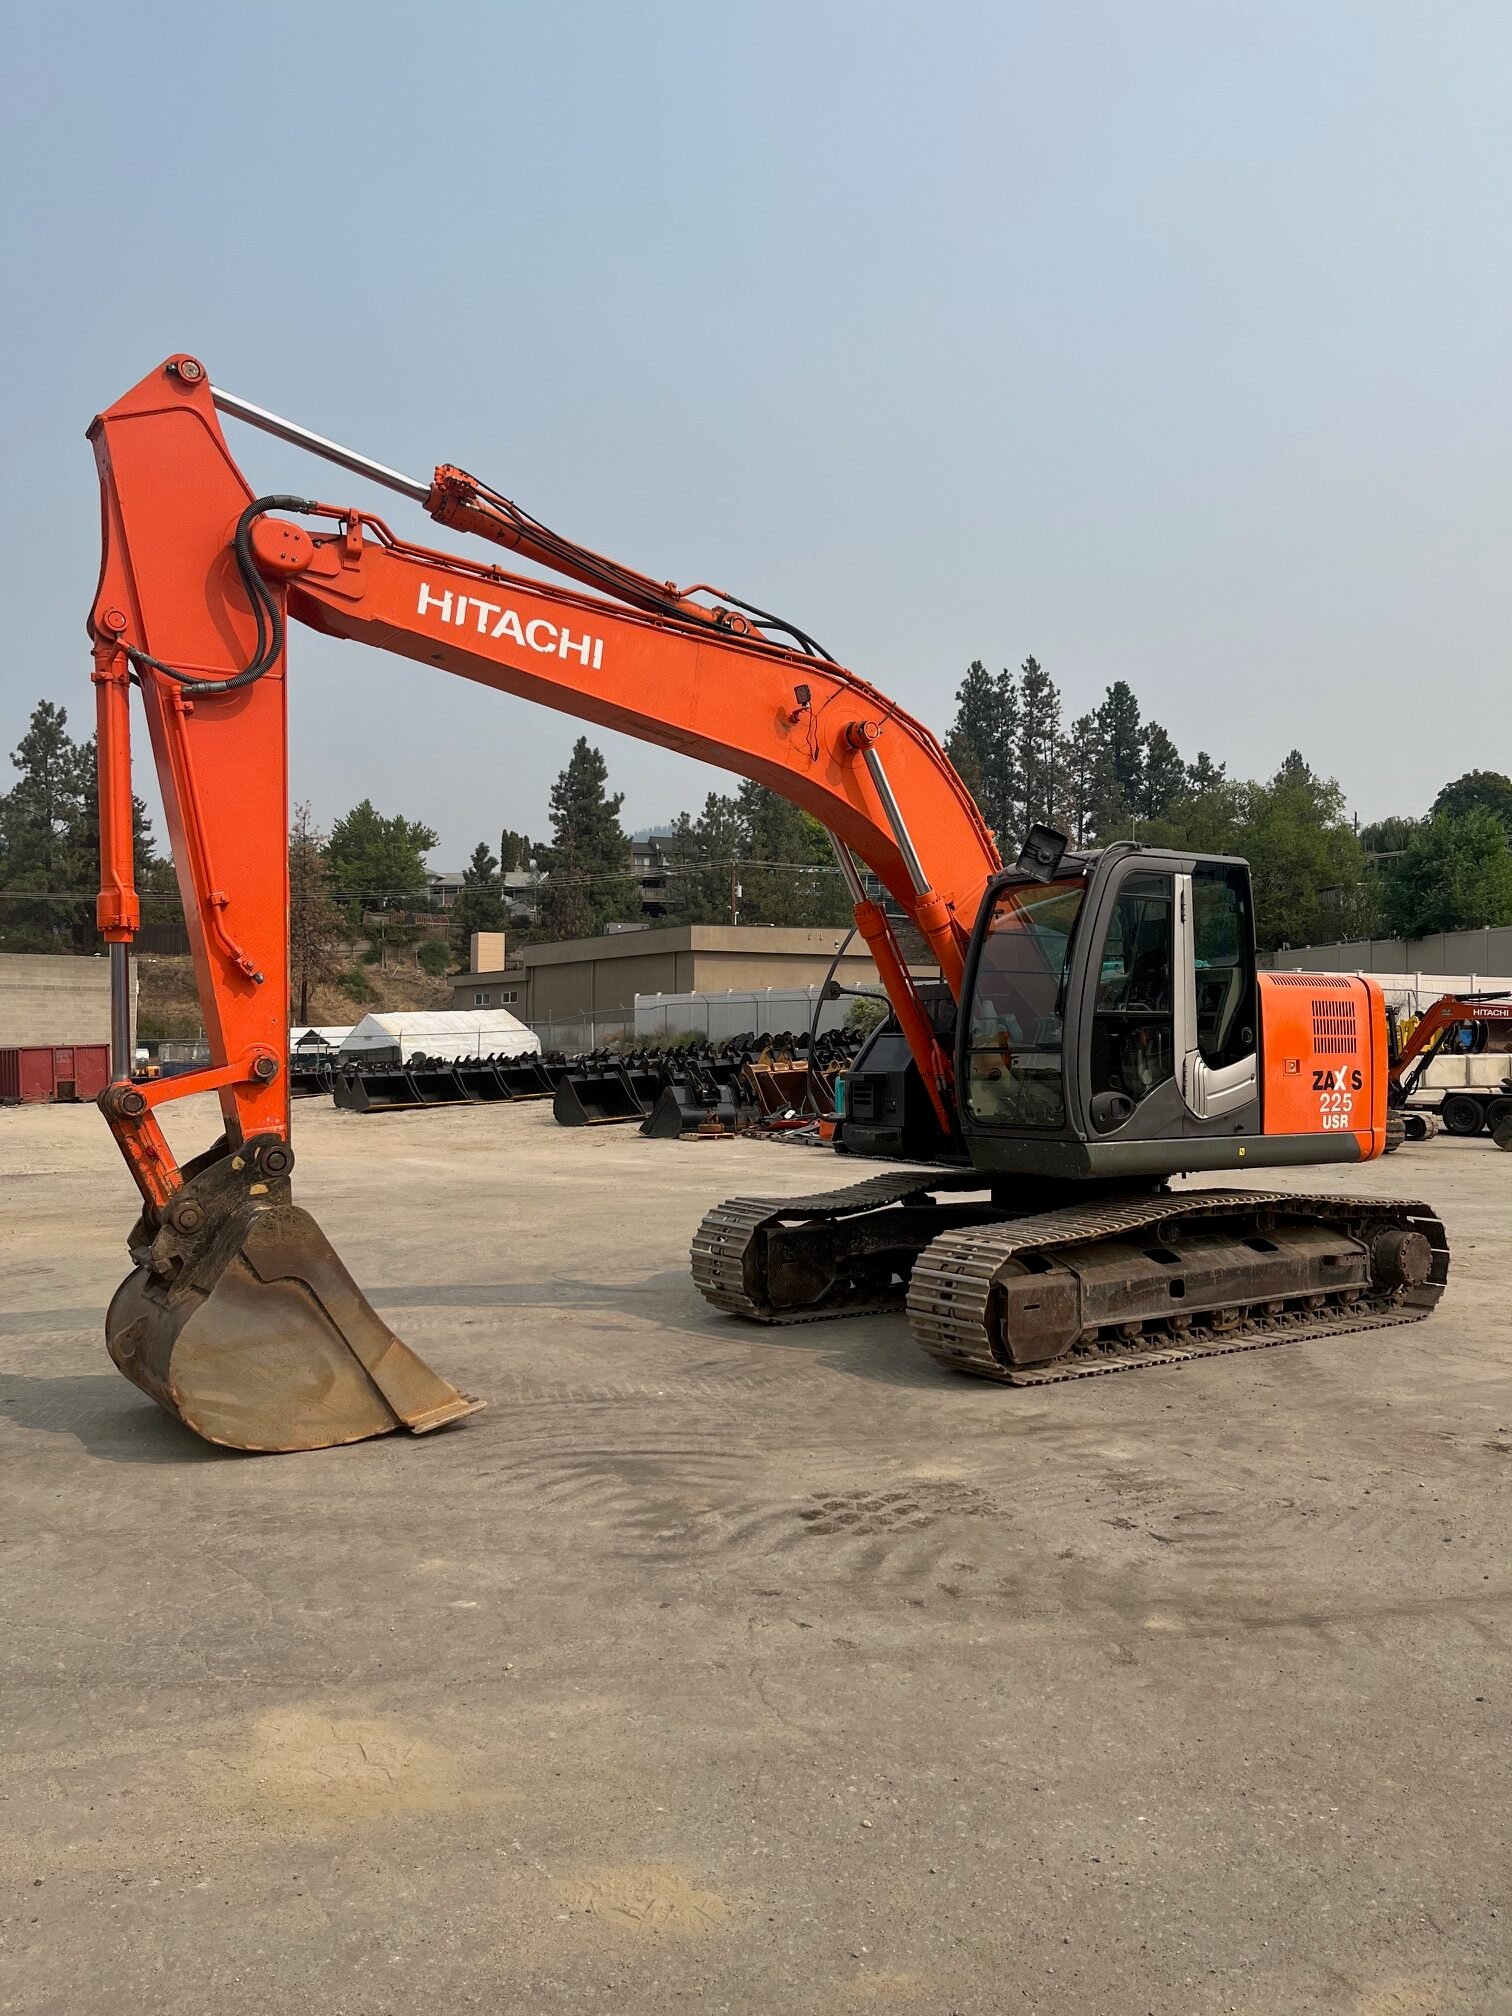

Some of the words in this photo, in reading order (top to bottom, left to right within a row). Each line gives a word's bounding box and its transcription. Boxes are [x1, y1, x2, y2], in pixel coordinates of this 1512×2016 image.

[417, 582, 604, 670] HITACHI
[1320, 1093, 1352, 1112] 225
[1322, 1114, 1349, 1129] USR
